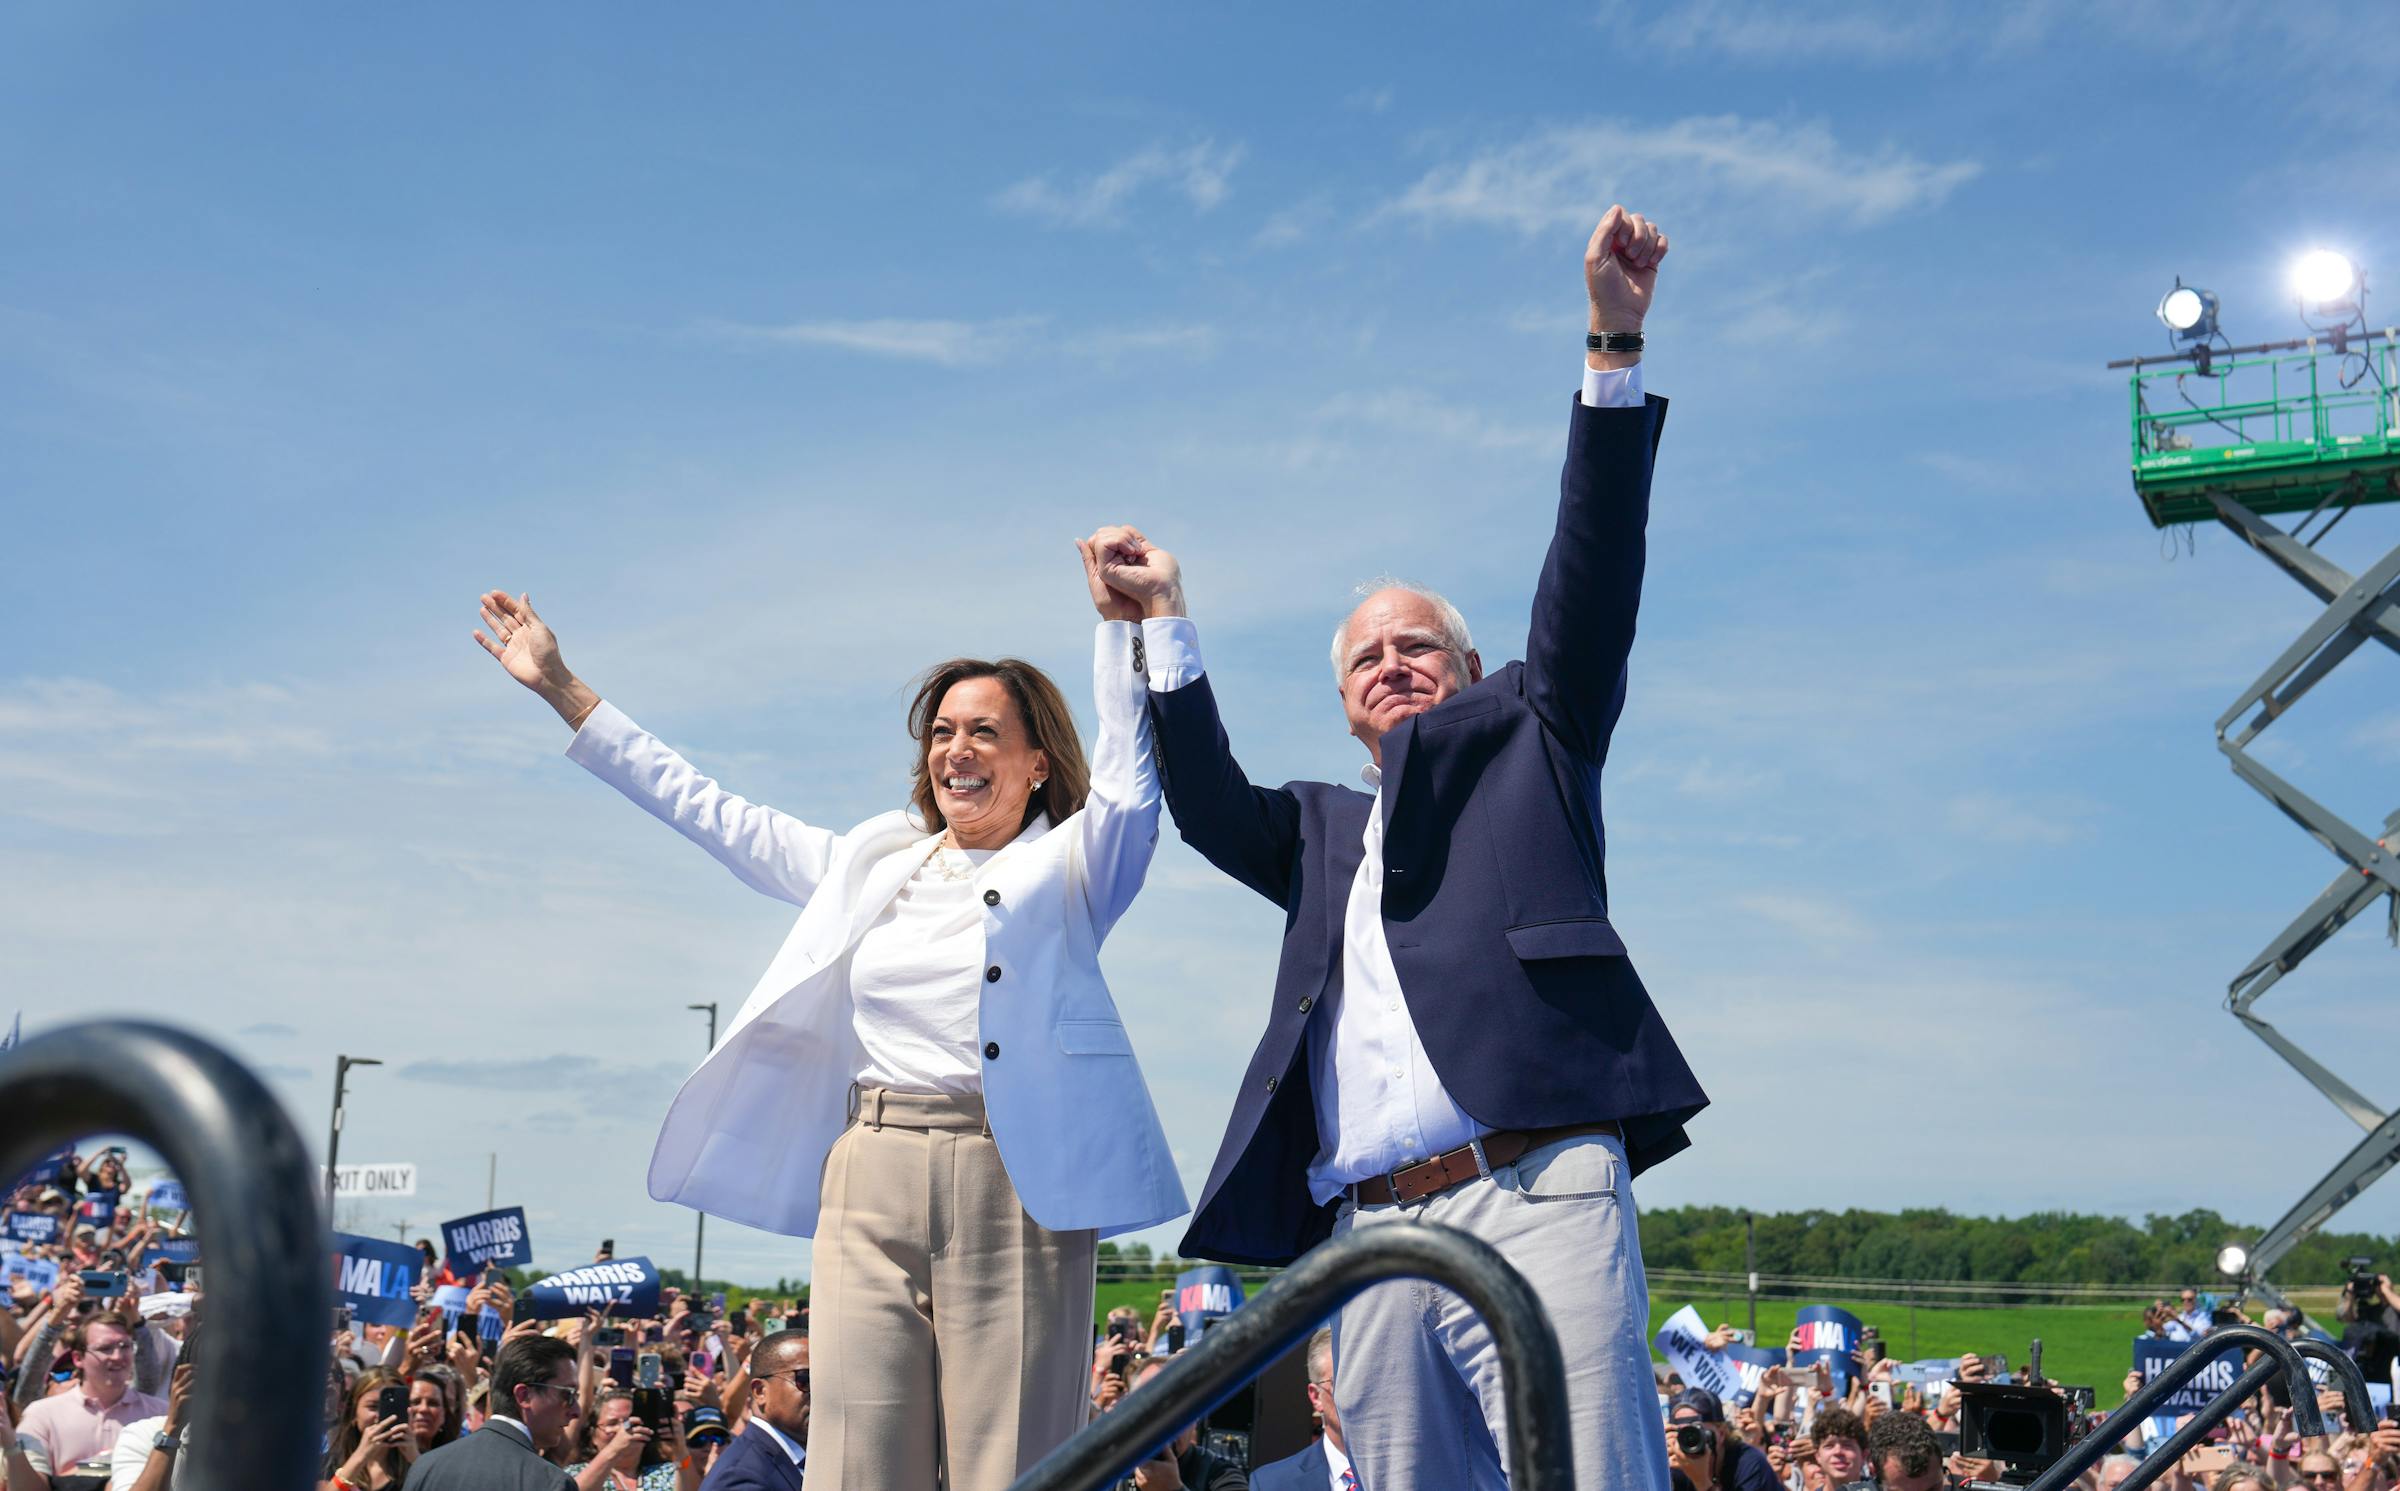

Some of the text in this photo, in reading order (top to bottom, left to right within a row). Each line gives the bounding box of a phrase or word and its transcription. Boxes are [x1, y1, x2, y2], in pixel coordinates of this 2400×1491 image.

[333, 1169, 411, 1190] XIT ONLY
[451, 1215, 522, 1253] HARRIS
[468, 1242, 514, 1264] WALZ
[333, 1253, 410, 1300] MALA
[564, 1285, 633, 1305] WALZ
[1180, 1283, 1233, 1314] KAMA
[1670, 1330, 1697, 1363] WE
[1694, 1355, 1726, 1394] WIN
